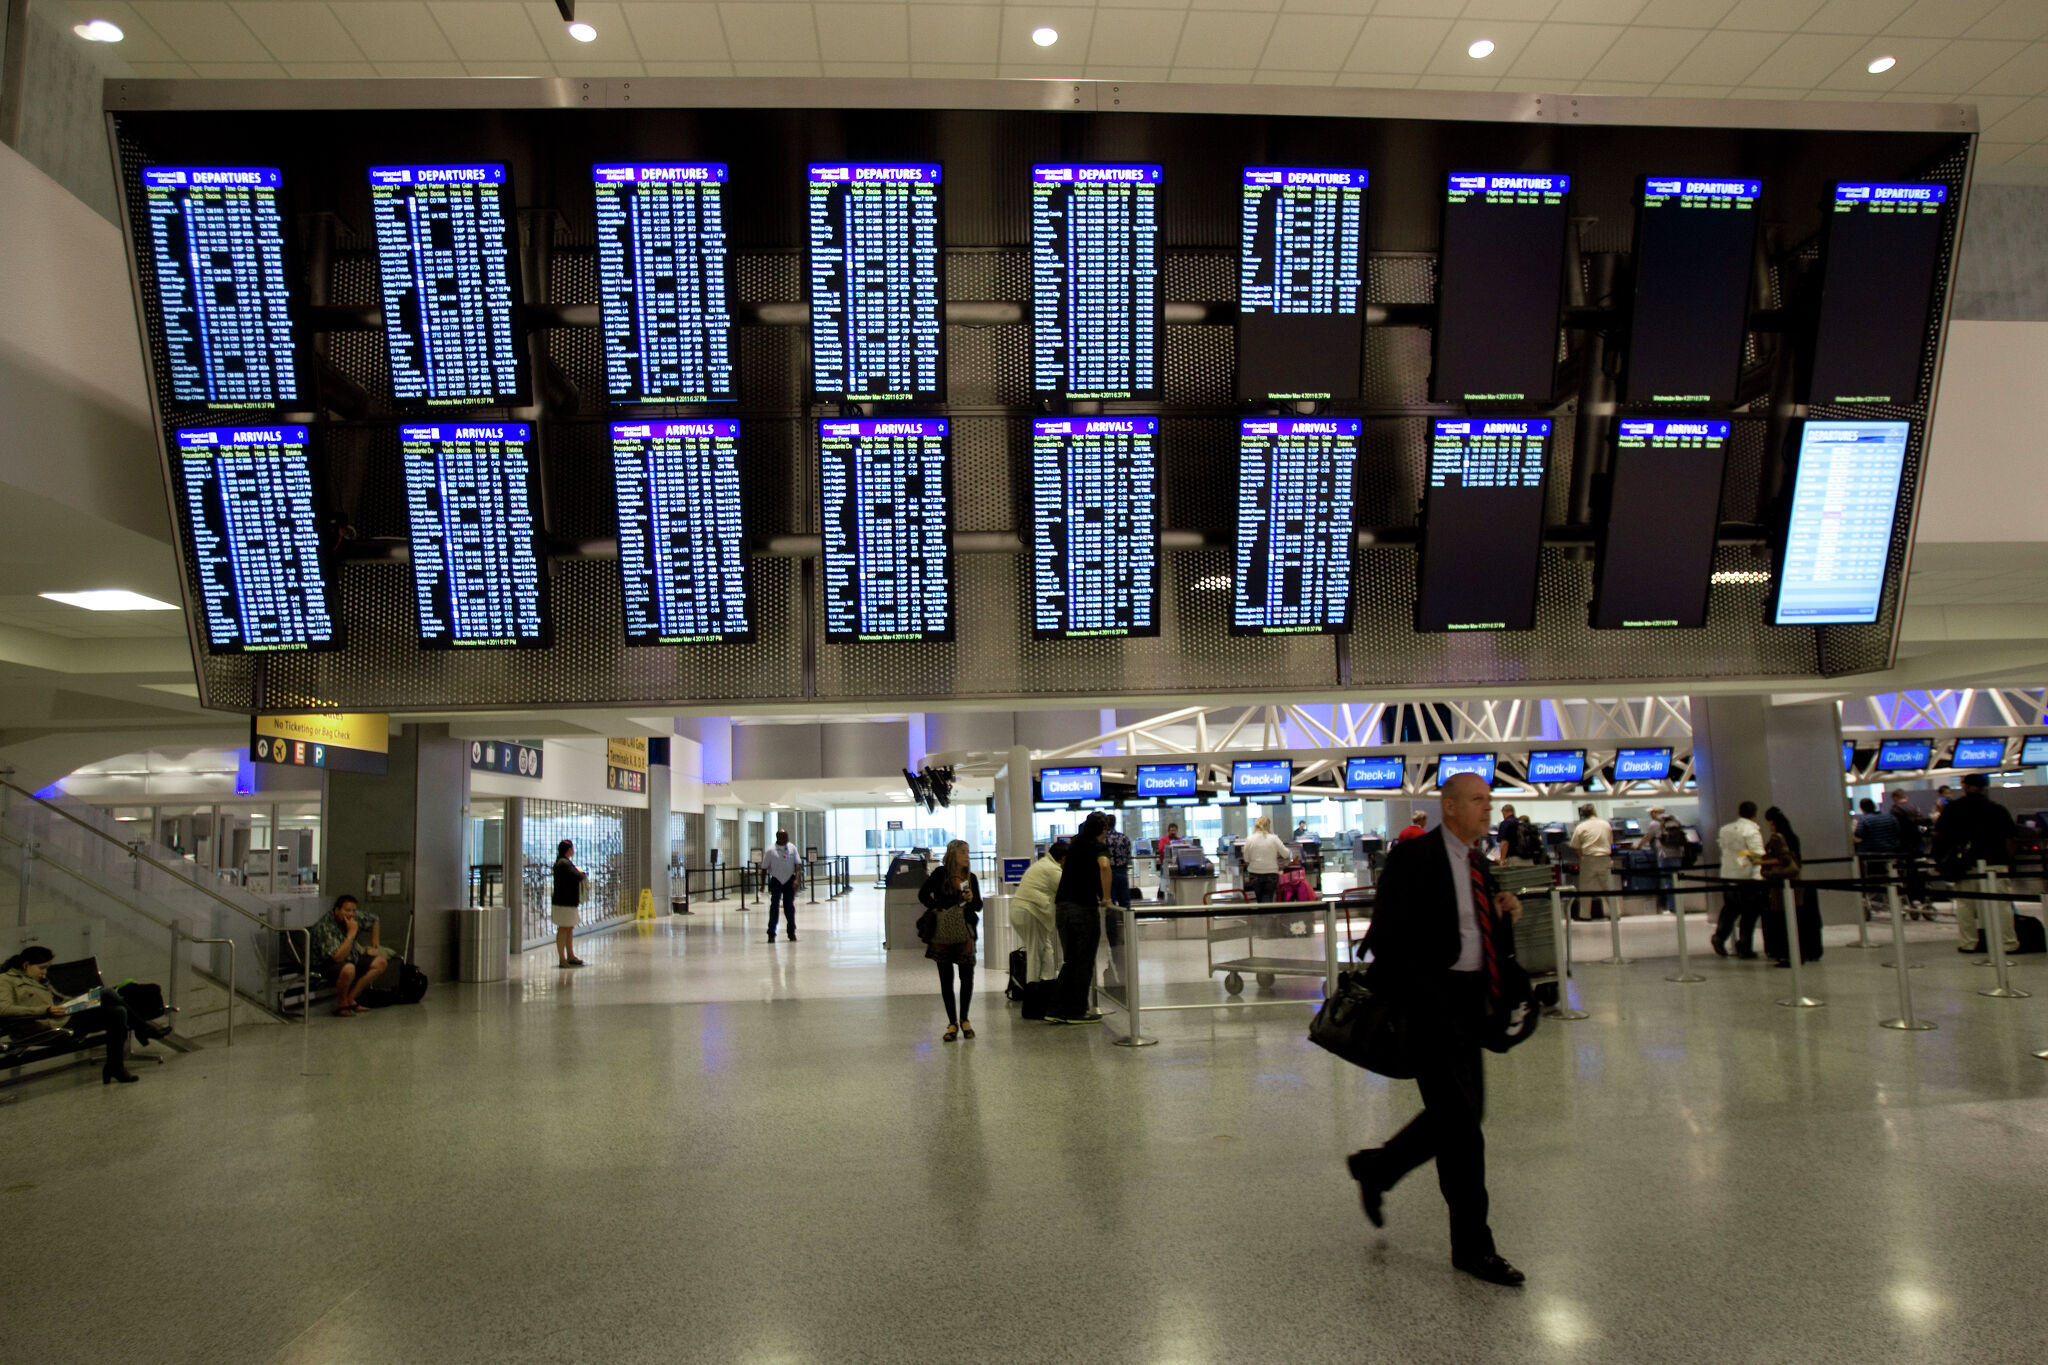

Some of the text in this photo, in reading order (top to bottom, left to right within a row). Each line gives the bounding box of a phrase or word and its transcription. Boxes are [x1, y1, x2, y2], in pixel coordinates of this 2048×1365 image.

[193, 172, 261, 184] DEPARTURES
[418, 170, 485, 181] DEPARTURES
[642, 168, 708, 180] DEPARTURES
[856, 168, 922, 180] DEPARTURES
[1079, 169, 1144, 180] DEPARTURES
[1288, 173, 1350, 184] DEPARTURES
[1492, 178, 1552, 189] DEPARTURES
[1686, 183, 1744, 194] DEPARTURES
[1875, 188, 1930, 198] DEPARTURES
[666, 424, 714, 436] ARRIVALS
[875, 424, 922, 434] ARRIVALS
[1086, 422, 1133, 432] ARRIVALS
[1292, 423, 1337, 433] ARRIVALS
[1484, 424, 1528, 434] ARRIVALS
[1666, 424, 1708, 434] ARRIVALS
[234, 431, 282, 442] ARRIVALS
[456, 428, 504, 438] ARRIVALS
[274, 720, 282, 728] No
[285, 721, 313, 736] Ticketing
[322, 727, 333, 738] Bag
[334, 730, 350, 740] Check
[296, 743, 304, 759] E
[316, 746, 322, 763] P
[1960, 750, 1998, 760] Check-in
[504, 748, 511, 768] P
[1886, 752, 1924, 762] Check-in
[1537, 764, 1576, 775] Check-in
[1623, 762, 1662, 772] Check-in
[1240, 774, 1282, 784] Check-in
[1354, 770, 1395, 780] Check-in
[1050, 781, 1092, 792] Check-in
[1146, 777, 1188, 788] Check-in
